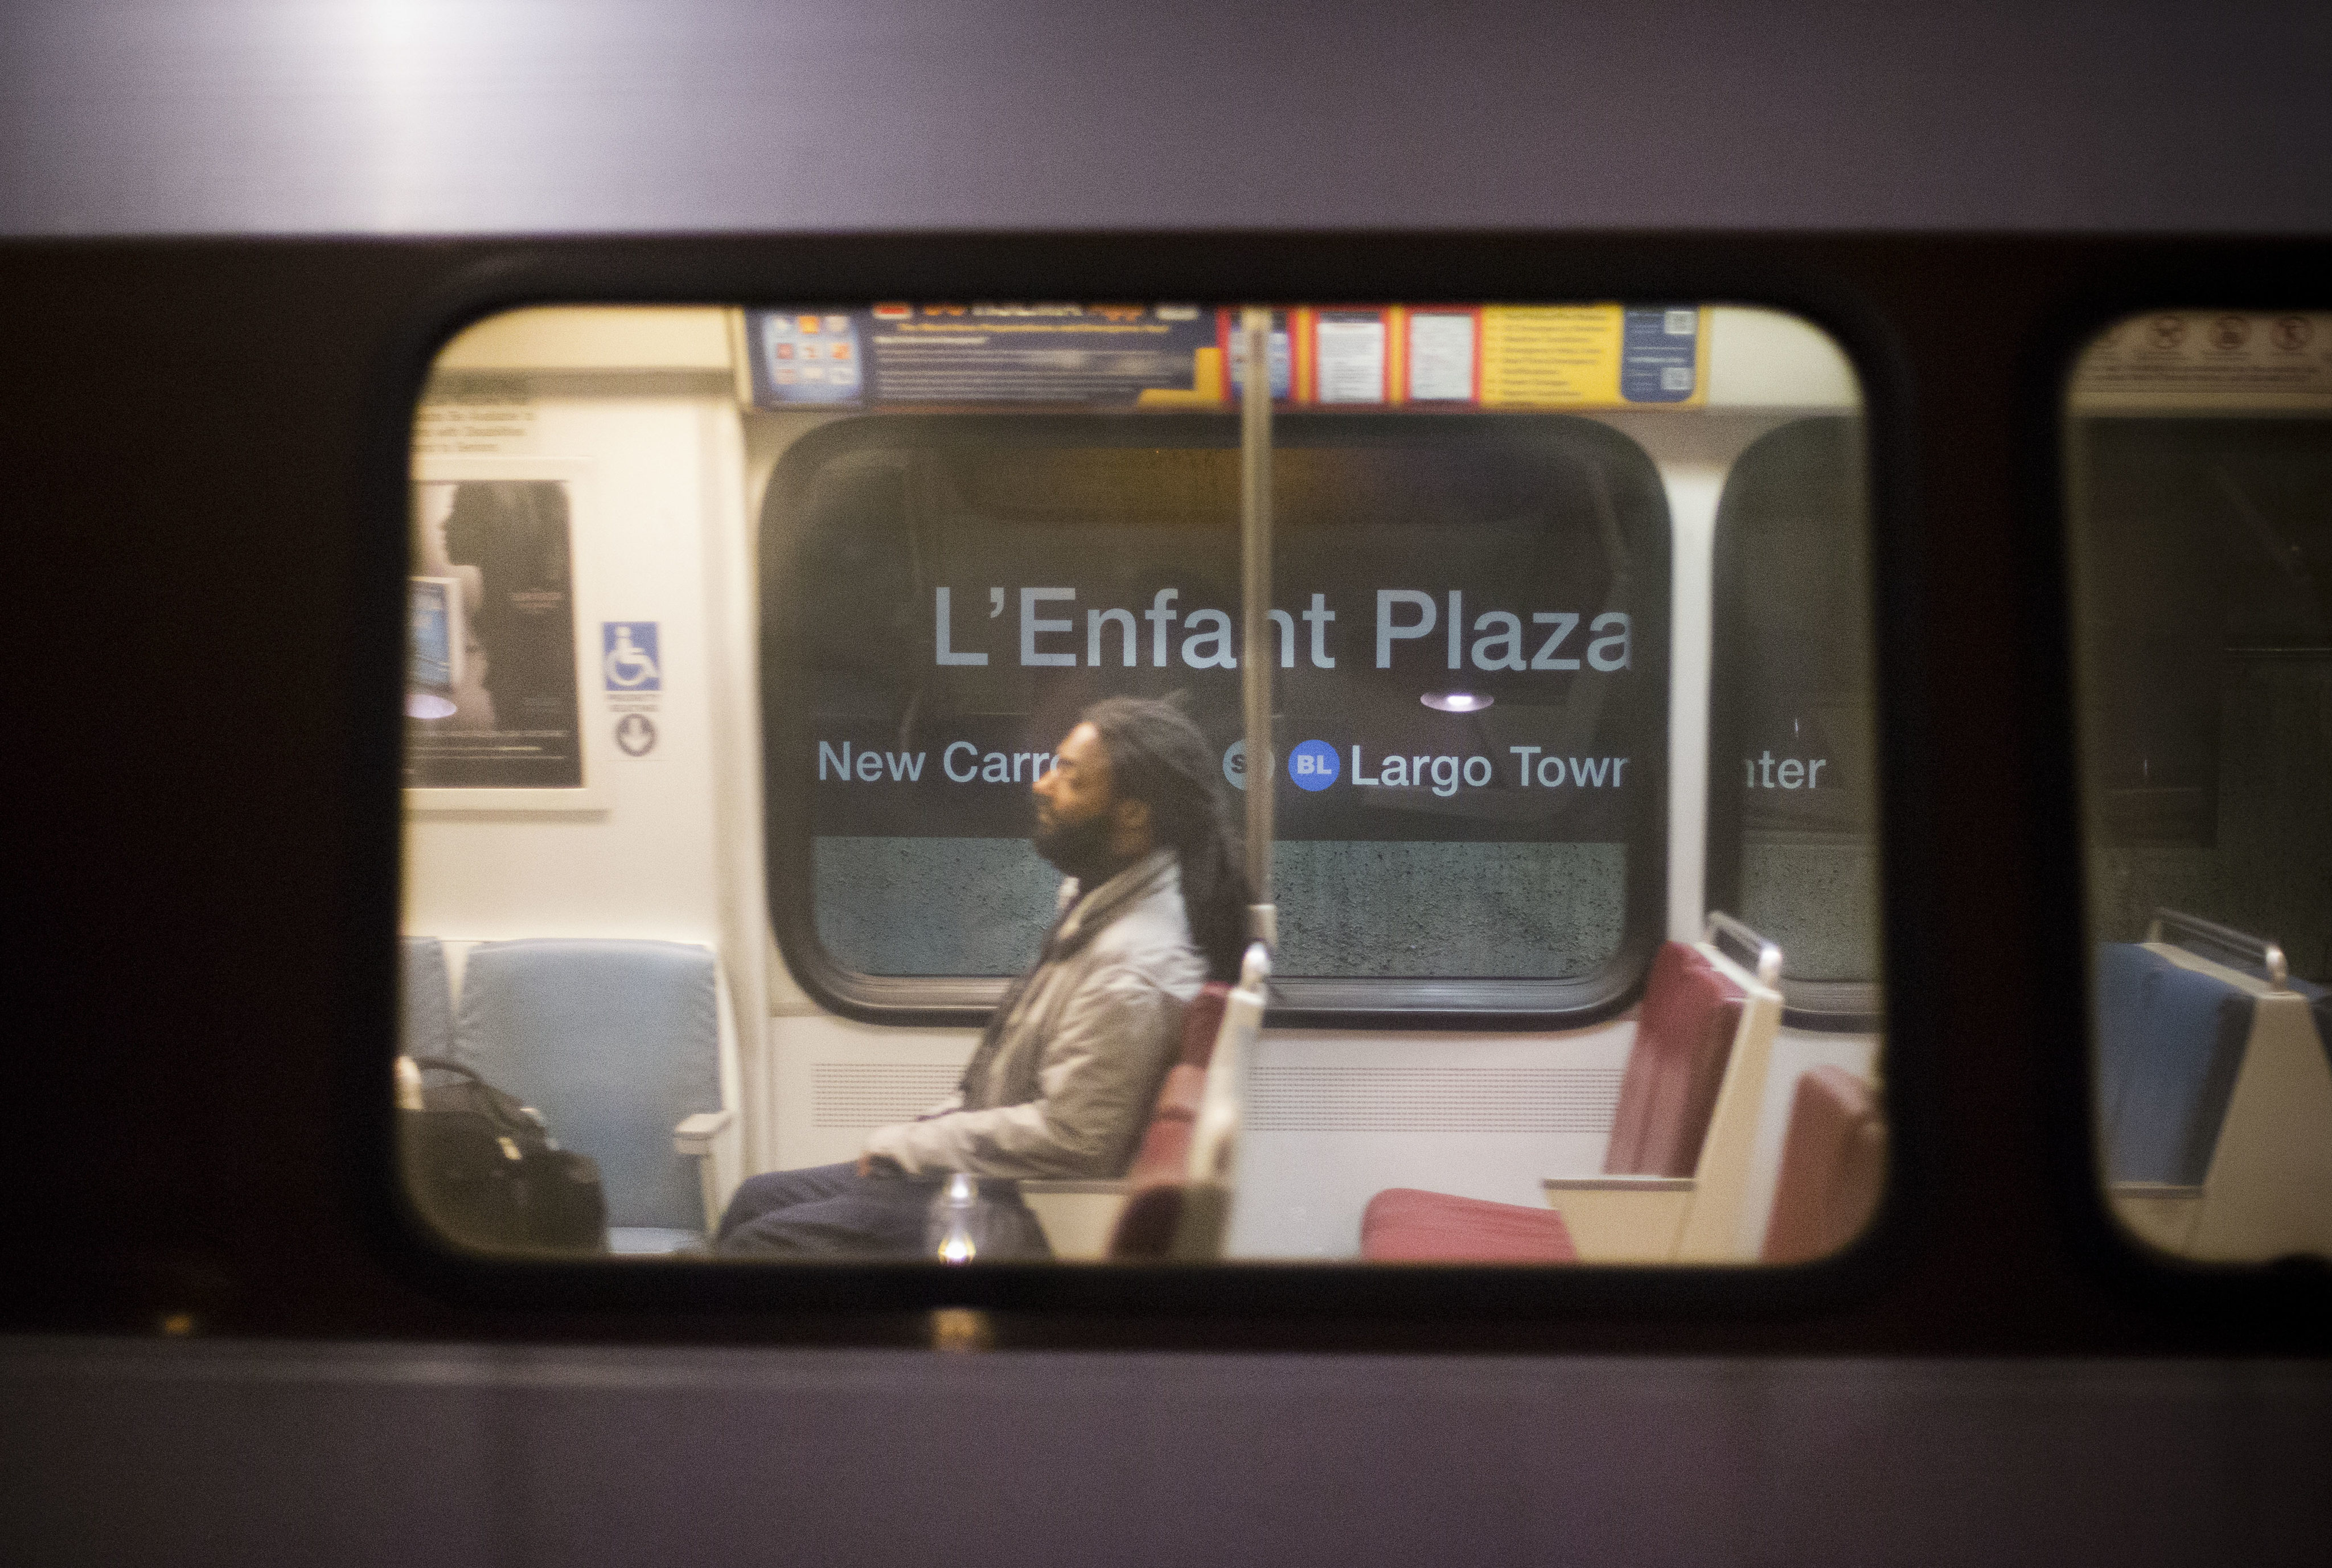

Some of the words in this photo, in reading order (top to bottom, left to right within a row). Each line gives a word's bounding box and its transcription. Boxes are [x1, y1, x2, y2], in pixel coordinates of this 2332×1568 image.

[1376, 589, 1632, 672] Plaza
[818, 741, 926, 782] New
[1297, 754, 1332, 775] BL
[1352, 745, 1492, 797] Largo
